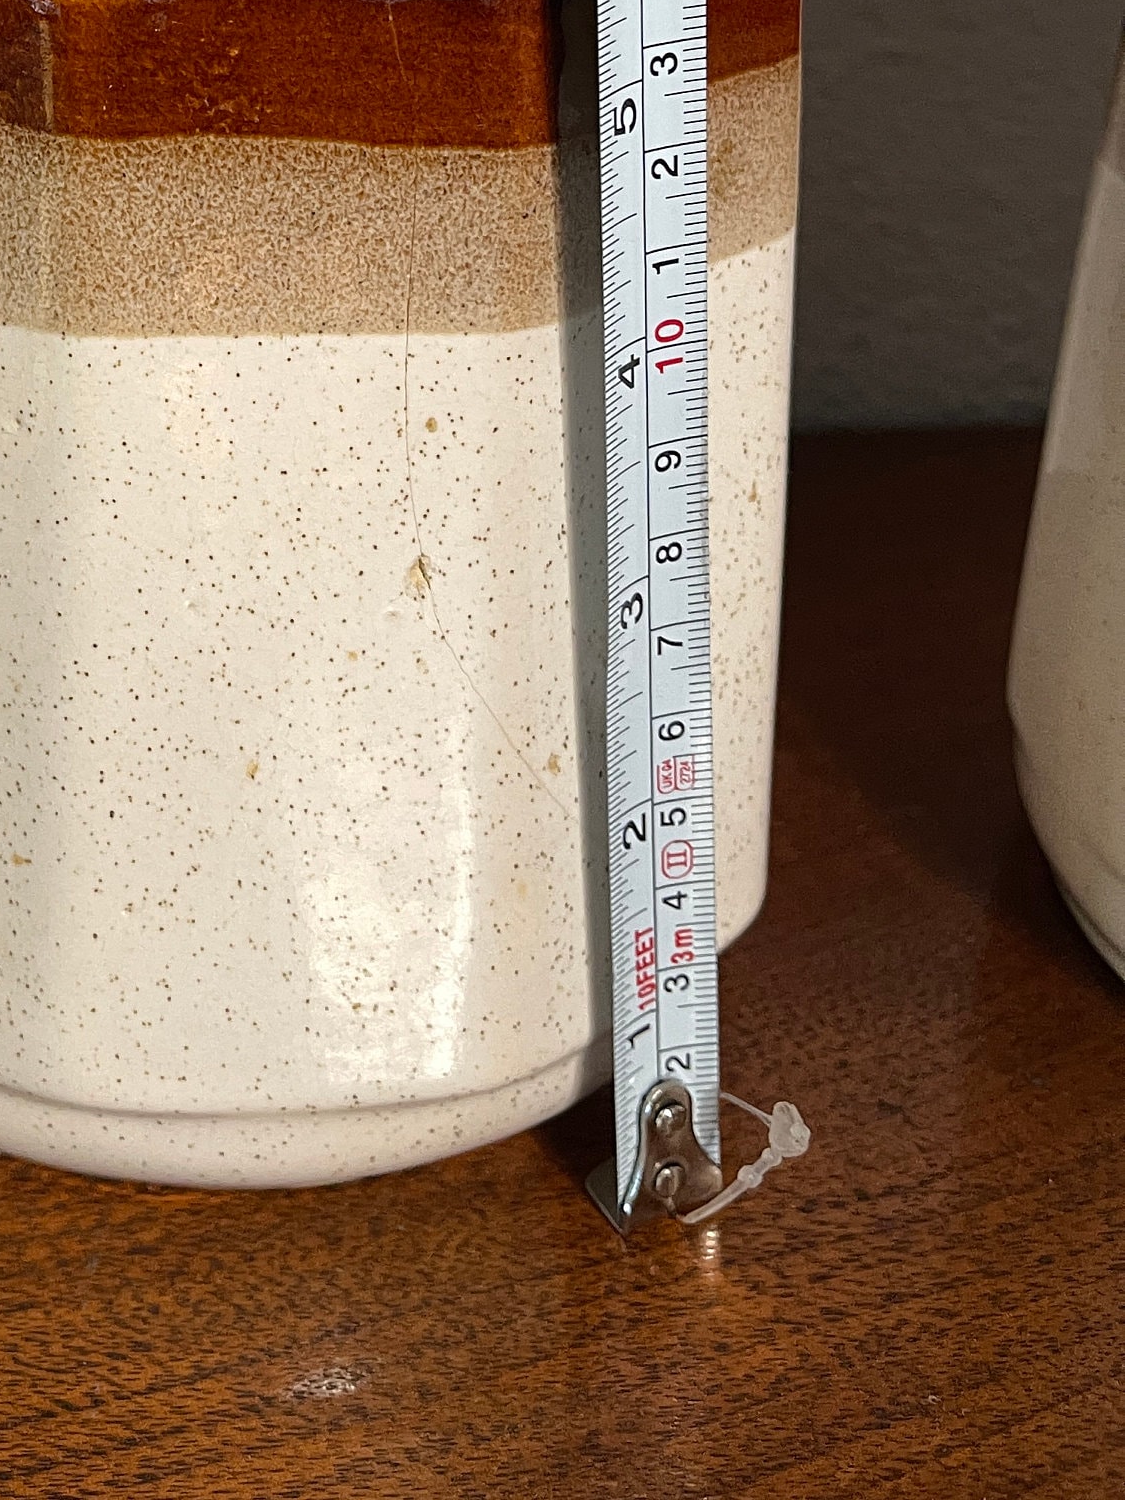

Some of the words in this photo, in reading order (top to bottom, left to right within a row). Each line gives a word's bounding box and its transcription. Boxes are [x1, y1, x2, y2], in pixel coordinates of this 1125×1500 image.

[650, 52, 678, 76] 3
[613, 97, 637, 136] 5
[651, 155, 679, 180] 2
[652, 258, 680, 275] 1
[654, 319, 684, 374] 10
[618, 354, 641, 389] 4
[655, 450, 681, 473] 9
[656, 541, 682, 564] 8
[620, 592, 643, 630] 3
[657, 635, 683, 655] 7
[658, 720, 685, 741] 6
[660, 807, 686, 827] 5
[622, 812, 647, 850] 2
[662, 891, 688, 910] 4
[663, 973, 690, 993] 3
[625, 1023, 651, 1048] 1
[666, 1053, 691, 1072] 2
